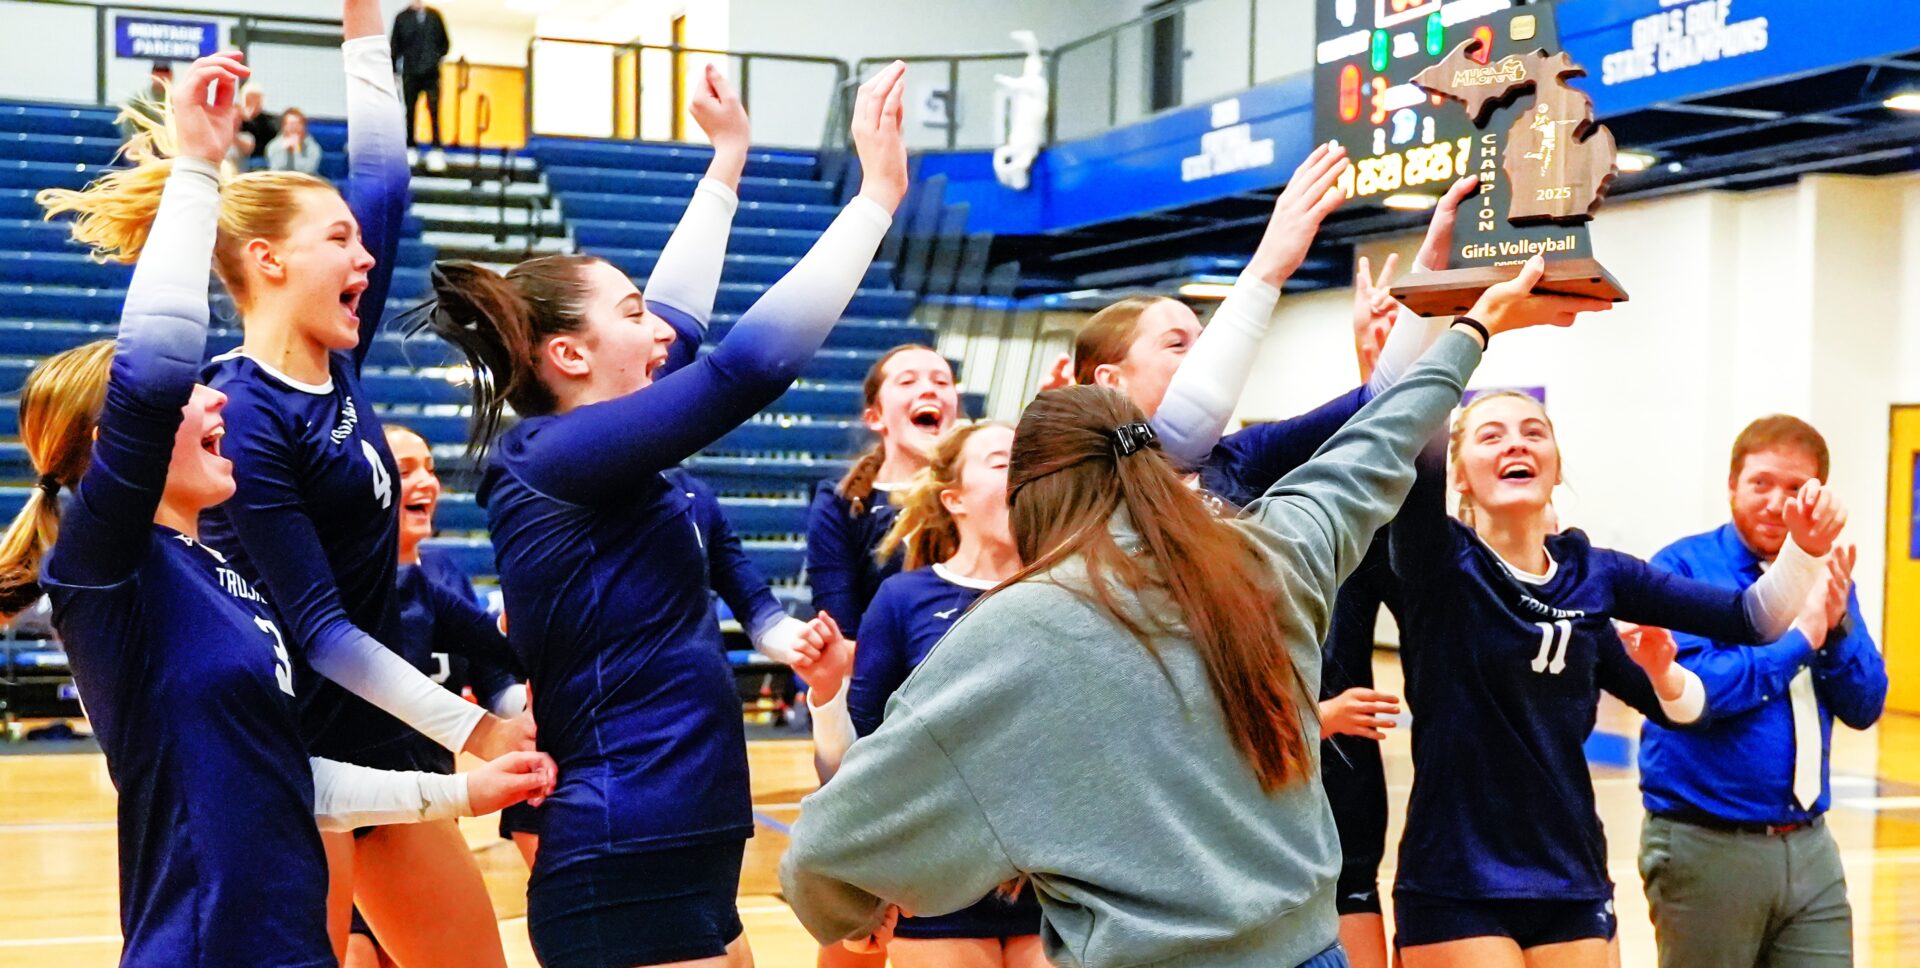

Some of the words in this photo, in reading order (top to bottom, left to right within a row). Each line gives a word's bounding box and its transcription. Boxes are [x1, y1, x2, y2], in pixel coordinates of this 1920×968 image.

[127, 22, 204, 42] MONTAGUE
[132, 38, 200, 58] PARENTS
[1657, 16, 1768, 73] CHAMPIONS
[1478, 133, 1497, 231] CHAMPION
[1537, 187, 1571, 201] 2025
[1461, 242, 1497, 259] Girls
[1499, 235, 1576, 258] Volleyball
[360, 438, 393, 510] 4
[215, 566, 269, 604] TROJ
[252, 613, 297, 698] 3
[1530, 619, 1572, 675] 11
